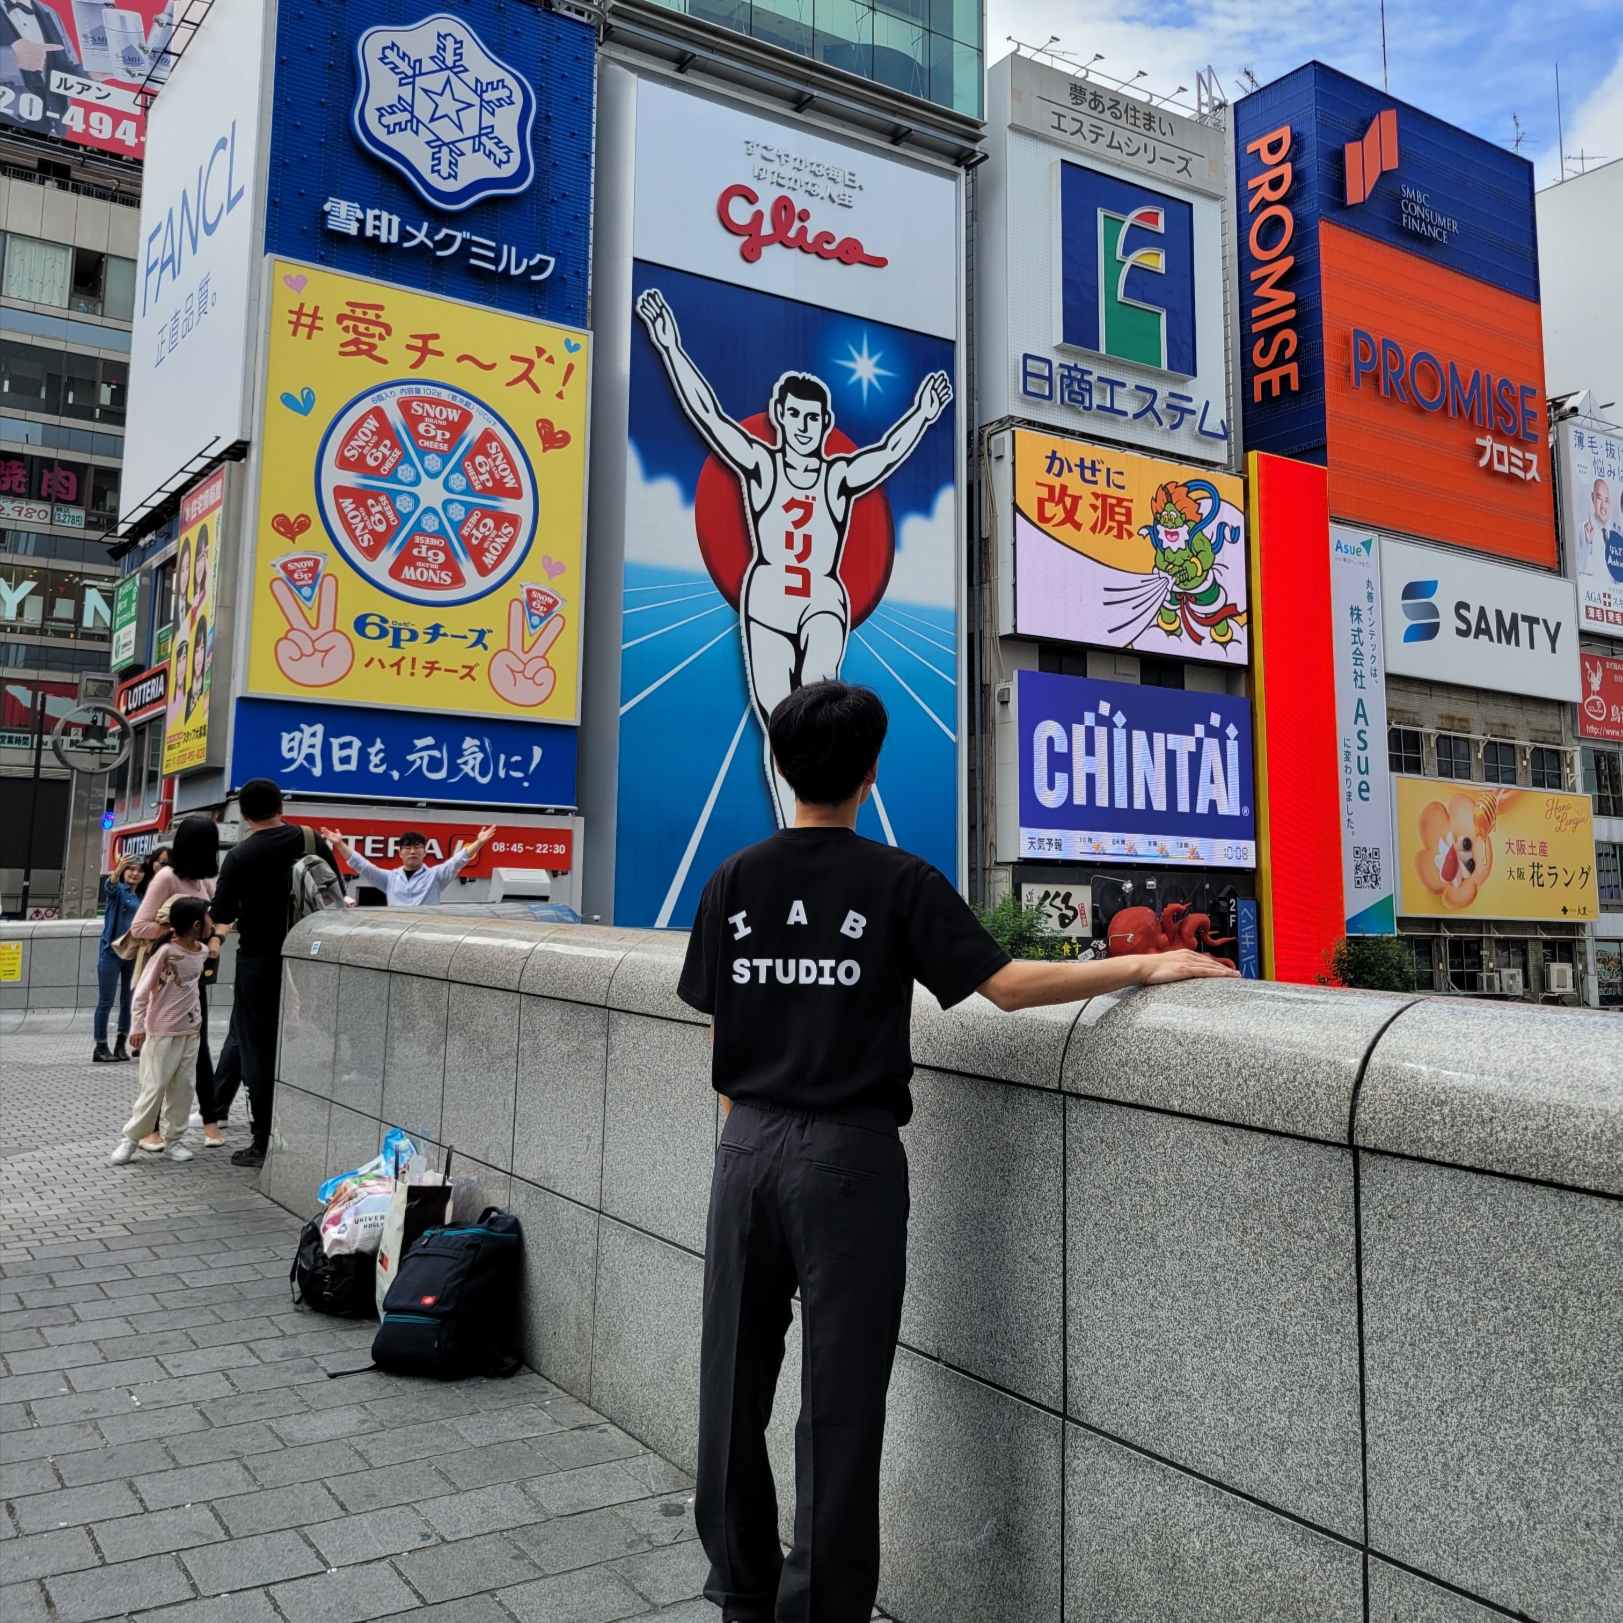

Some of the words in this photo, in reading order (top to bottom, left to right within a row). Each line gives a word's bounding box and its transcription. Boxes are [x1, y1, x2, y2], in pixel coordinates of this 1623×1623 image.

[56, 77, 111, 100] ルアン
[1068, 82, 1175, 137] 夢ある住まい
[1051, 111, 1193, 178] エステムシリーズ
[753, 161, 853, 209] ゆたかな人生
[1401, 184, 1430, 207] SMBC
[143, 118, 245, 318] FANCL
[717, 184, 888, 268] Glico
[1401, 199, 1459, 235] CONSUMER
[1402, 213, 1448, 244] FINANCE
[323, 196, 556, 282] 雪印メグミルク
[1246, 125, 1299, 403] PROMISE
[155, 271, 217, 369] 正直品質。
[1022, 352, 1229, 440] 日商エステム
[1350, 327, 1539, 443] PROMISE
[411, 401, 462, 422] SNOW
[344, 414, 380, 461] SNOW
[418, 439, 449, 451] CHEESE
[381, 448, 402, 474] CHEESE
[464, 461, 482, 491] CHEESE
[486, 442, 518, 488] SNOW
[1045, 449, 1126, 490] かぜに
[1475, 435, 1541, 482] プロミス
[54, 512, 83, 526] (3,278円)
[339, 498, 374, 547] SNOW
[379, 495, 398, 525] CHEESE
[461, 510, 481, 536] CHEESE
[1035, 480, 1135, 540] 改源
[415, 536, 445, 547] CHEESE
[482, 522, 514, 569] SNOW
[781, 495, 816, 598] グリコ
[1335, 539, 1362, 557] Asue
[287, 559, 314, 570] SNOW
[401, 566, 452, 585] SNOW
[531, 590, 554, 605] SNOW
[1585, 590, 1602, 604] AGA
[1366, 578, 1379, 684] 丸善インテックは、
[1454, 600, 1562, 654] SAMTY
[1349, 604, 1366, 689] 株式会社
[128, 674, 165, 710] LOTTERIA
[0, 733, 30, 746] 営業時間
[1353, 698, 1370, 802] Asue
[1343, 737, 1355, 836] に変わりました。
[1027, 836, 1063, 851] 天気予報
[1224, 846, 1248, 860] 10:08
[1505, 838, 1549, 857] 大阪土産
[1507, 866, 1525, 880] 大阪
[1528, 862, 1591, 890] 花ラング
[732, 958, 861, 986] STUDIO
